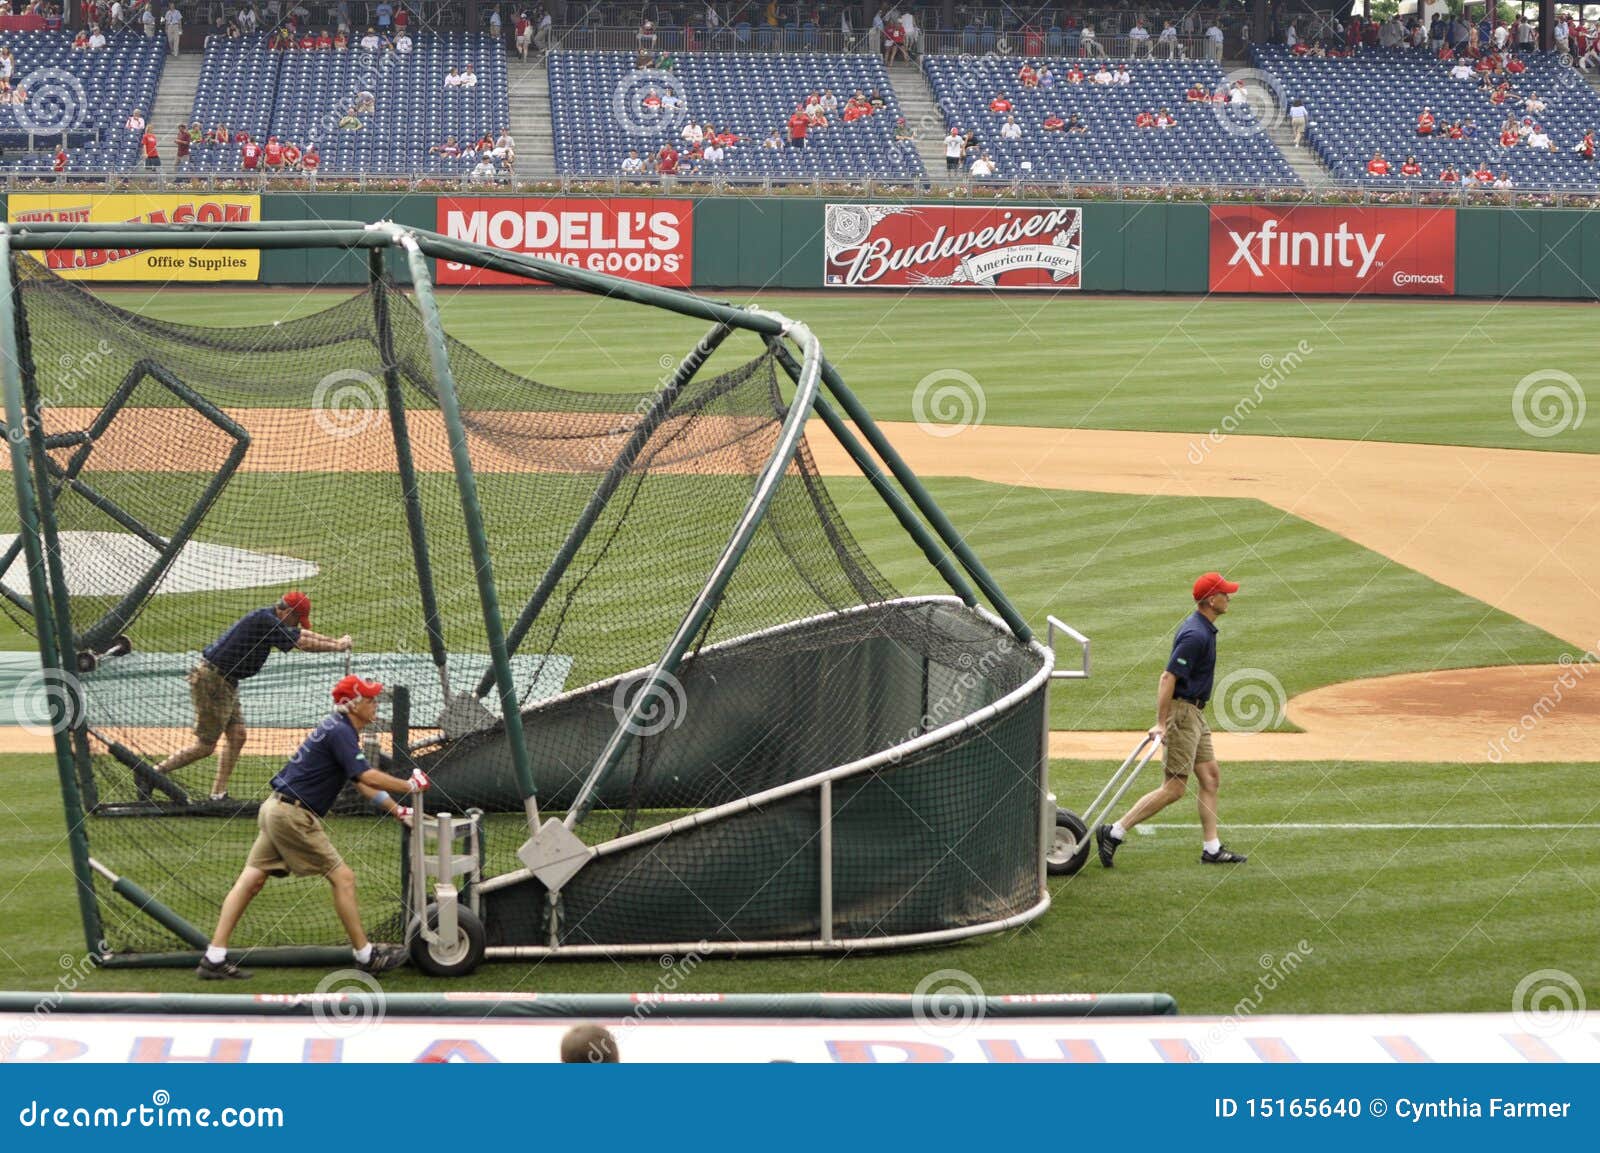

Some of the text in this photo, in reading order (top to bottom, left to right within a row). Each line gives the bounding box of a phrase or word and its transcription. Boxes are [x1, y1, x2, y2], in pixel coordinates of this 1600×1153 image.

[447, 210, 680, 250] MODELL'S
[830, 208, 1068, 285] Budweiser
[1228, 220, 1385, 277] xfinity
[147, 255, 247, 271] Office Supplies
[587, 252, 680, 273] GOODS
[975, 252, 1072, 275] American Lager
